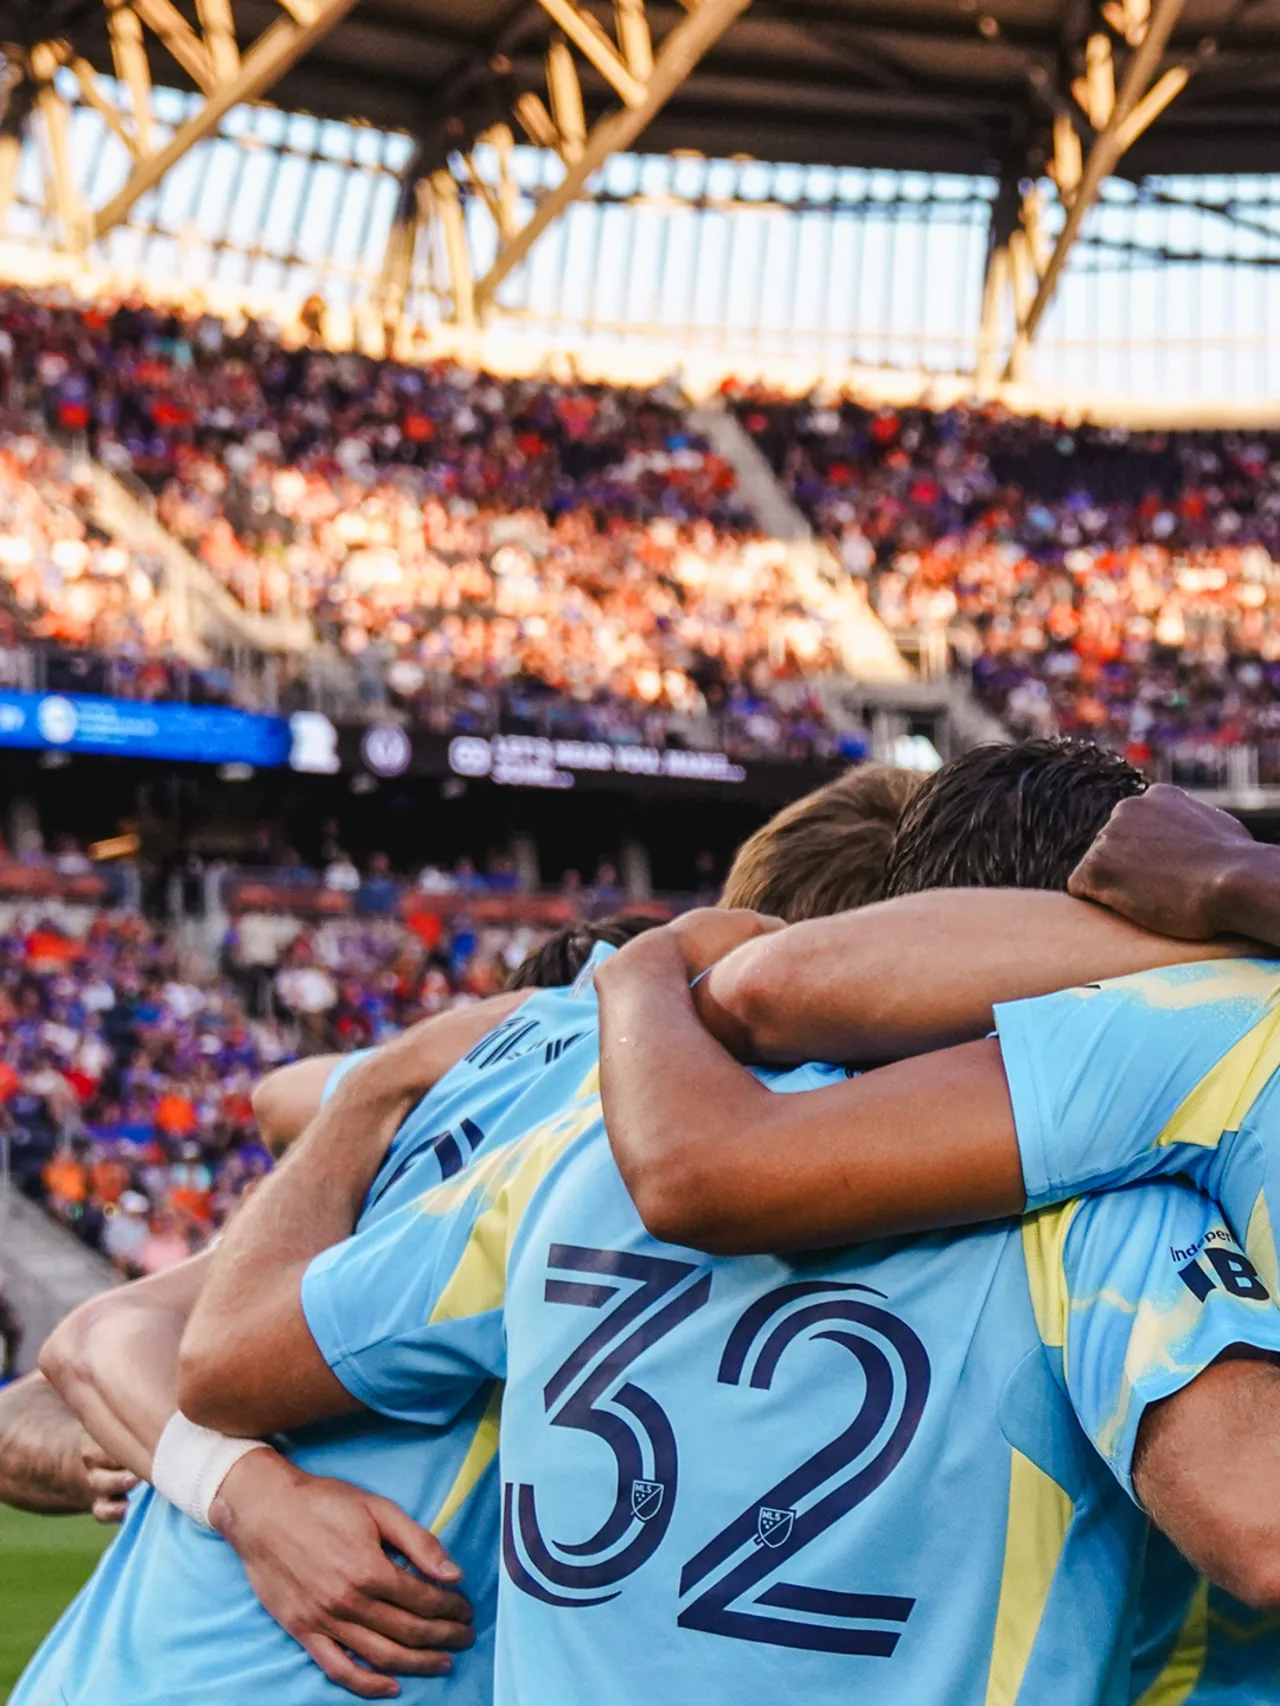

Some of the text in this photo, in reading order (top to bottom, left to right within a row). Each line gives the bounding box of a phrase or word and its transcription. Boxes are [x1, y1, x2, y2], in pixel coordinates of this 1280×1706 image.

[503, 1243, 931, 1657] 32
[635, 1484, 653, 1494] MLS
[762, 1511, 781, 1521] MLS
